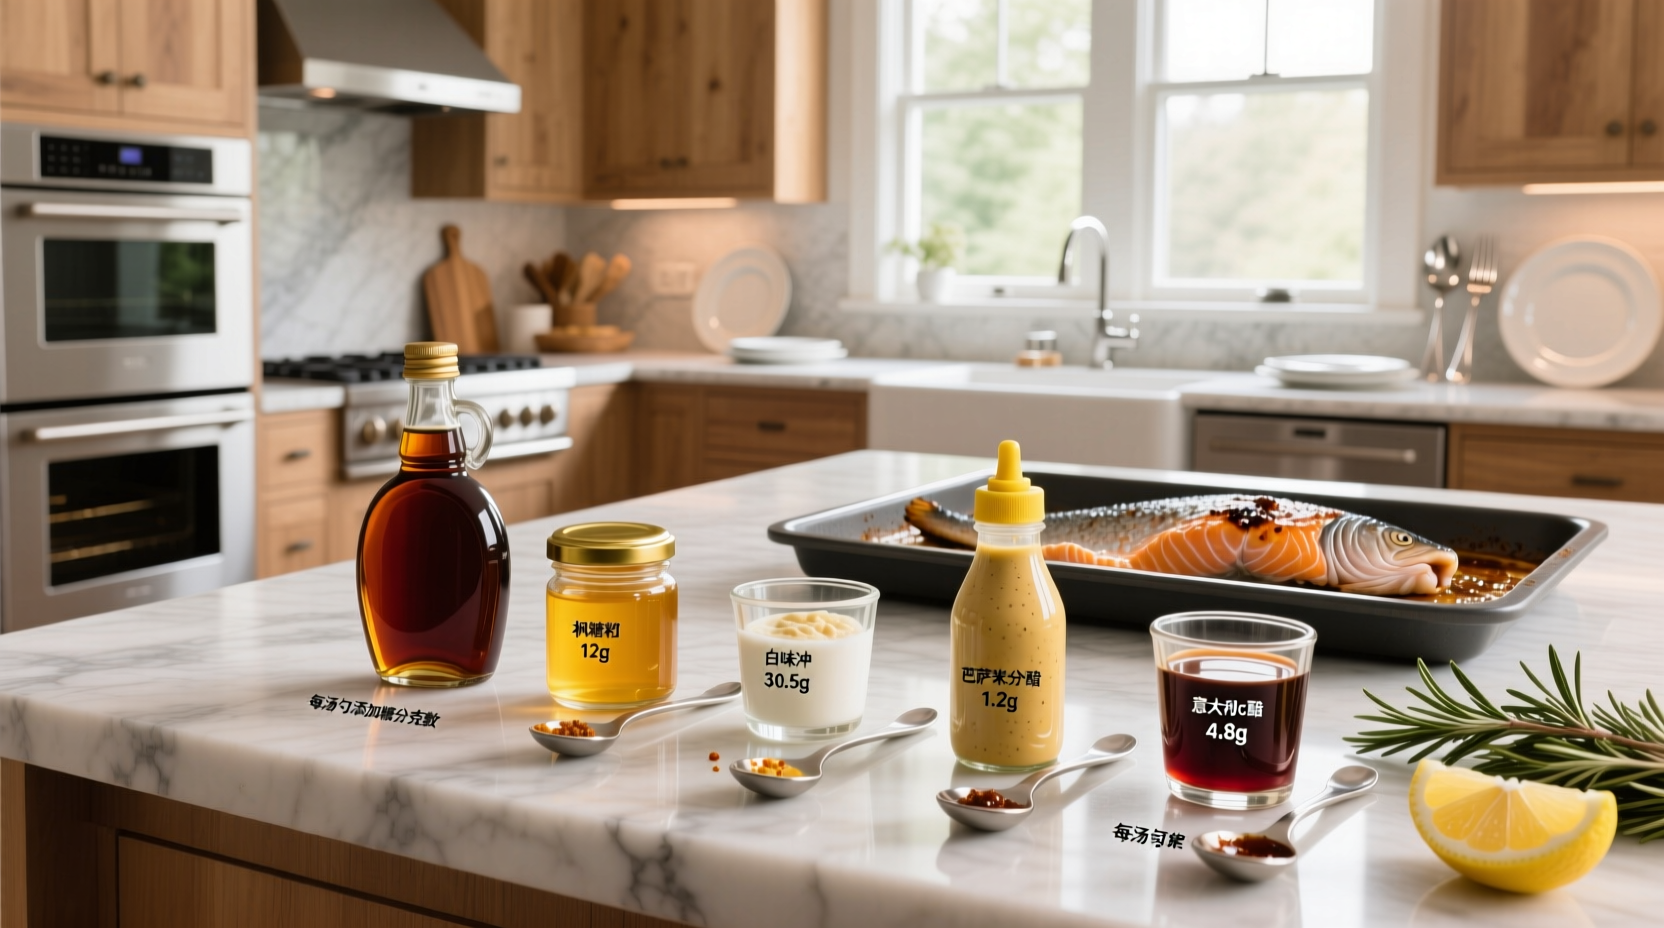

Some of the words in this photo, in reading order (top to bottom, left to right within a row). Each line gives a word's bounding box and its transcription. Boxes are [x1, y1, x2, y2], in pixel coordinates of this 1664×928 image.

[581, 643, 610, 663] 12g
[764, 672, 810, 694] 30.5g
[981, 691, 1018, 713] 1.2g
[1205, 722, 1248, 746] 4.8g
